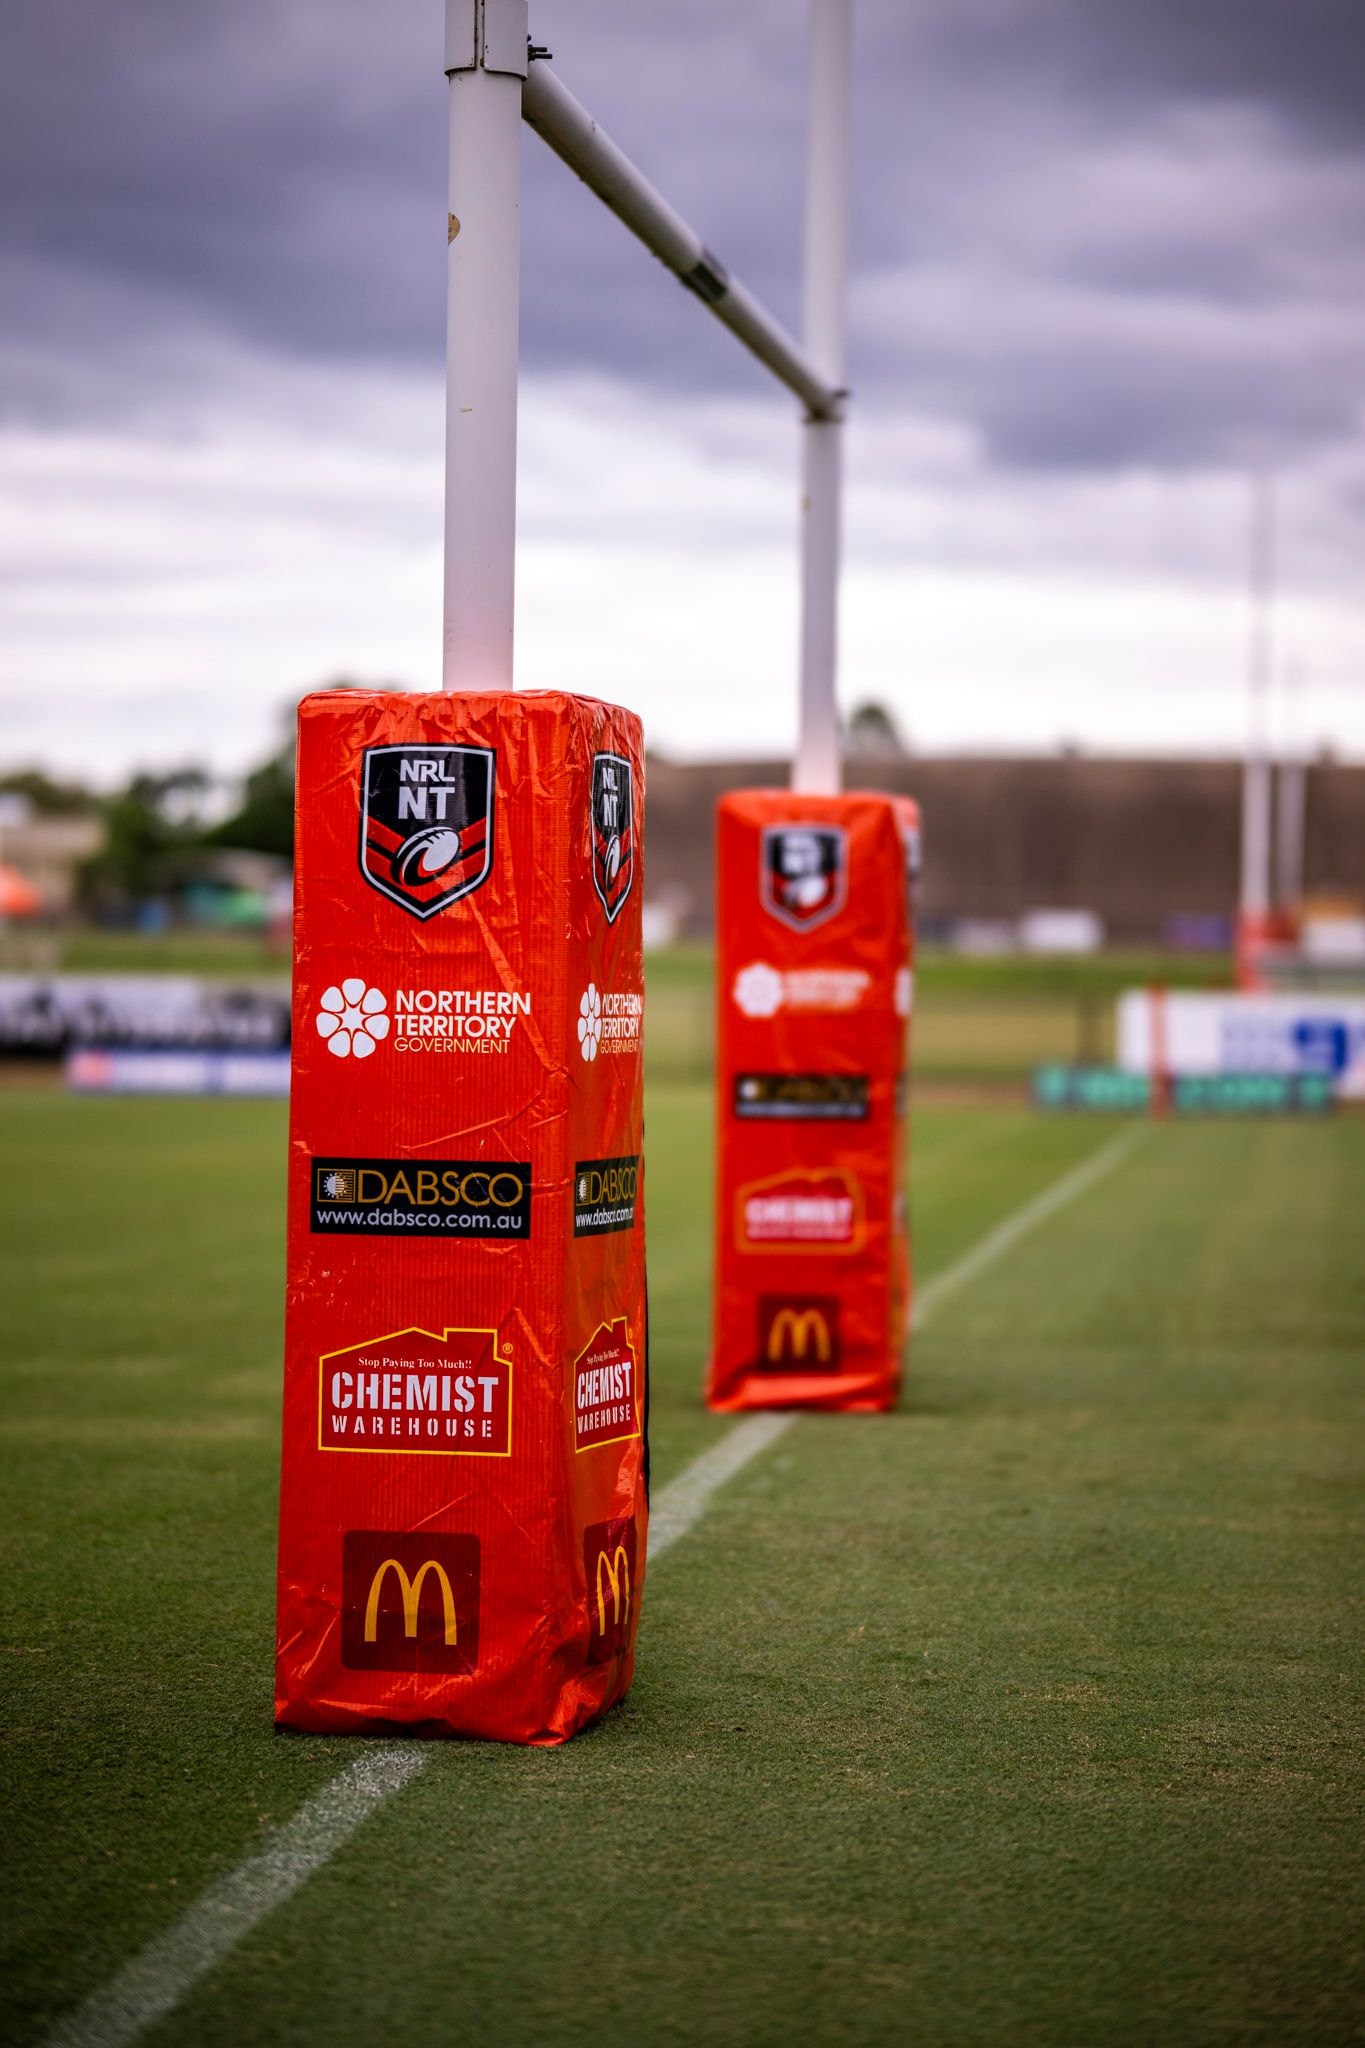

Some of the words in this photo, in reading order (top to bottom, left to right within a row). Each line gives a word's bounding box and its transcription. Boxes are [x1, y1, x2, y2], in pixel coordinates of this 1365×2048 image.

[400, 759, 455, 782] NRL
[398, 786, 455, 820] NT
[603, 793, 618, 828] NT
[396, 989, 531, 1015] NORTHERN
[394, 1014, 517, 1038] TERRITORY
[601, 1017, 639, 1038] TERRITORY
[394, 1037, 511, 1054] GOVERNMENT
[357, 1168, 524, 1207] DABSCO
[316, 1208, 522, 1229] www.dabsco.com.au
[358, 1357, 380, 1369] Stop
[382, 1357, 415, 1370] Paying
[417, 1358, 435, 1368] Too
[437, 1359, 472, 1369] Much!!
[331, 1371, 499, 1413] CHEMIST
[577, 1361, 632, 1410] CHEMIST
[331, 1415, 492, 1438] WAREHOUSE
[577, 1403, 631, 1434] WAREHOUSE
